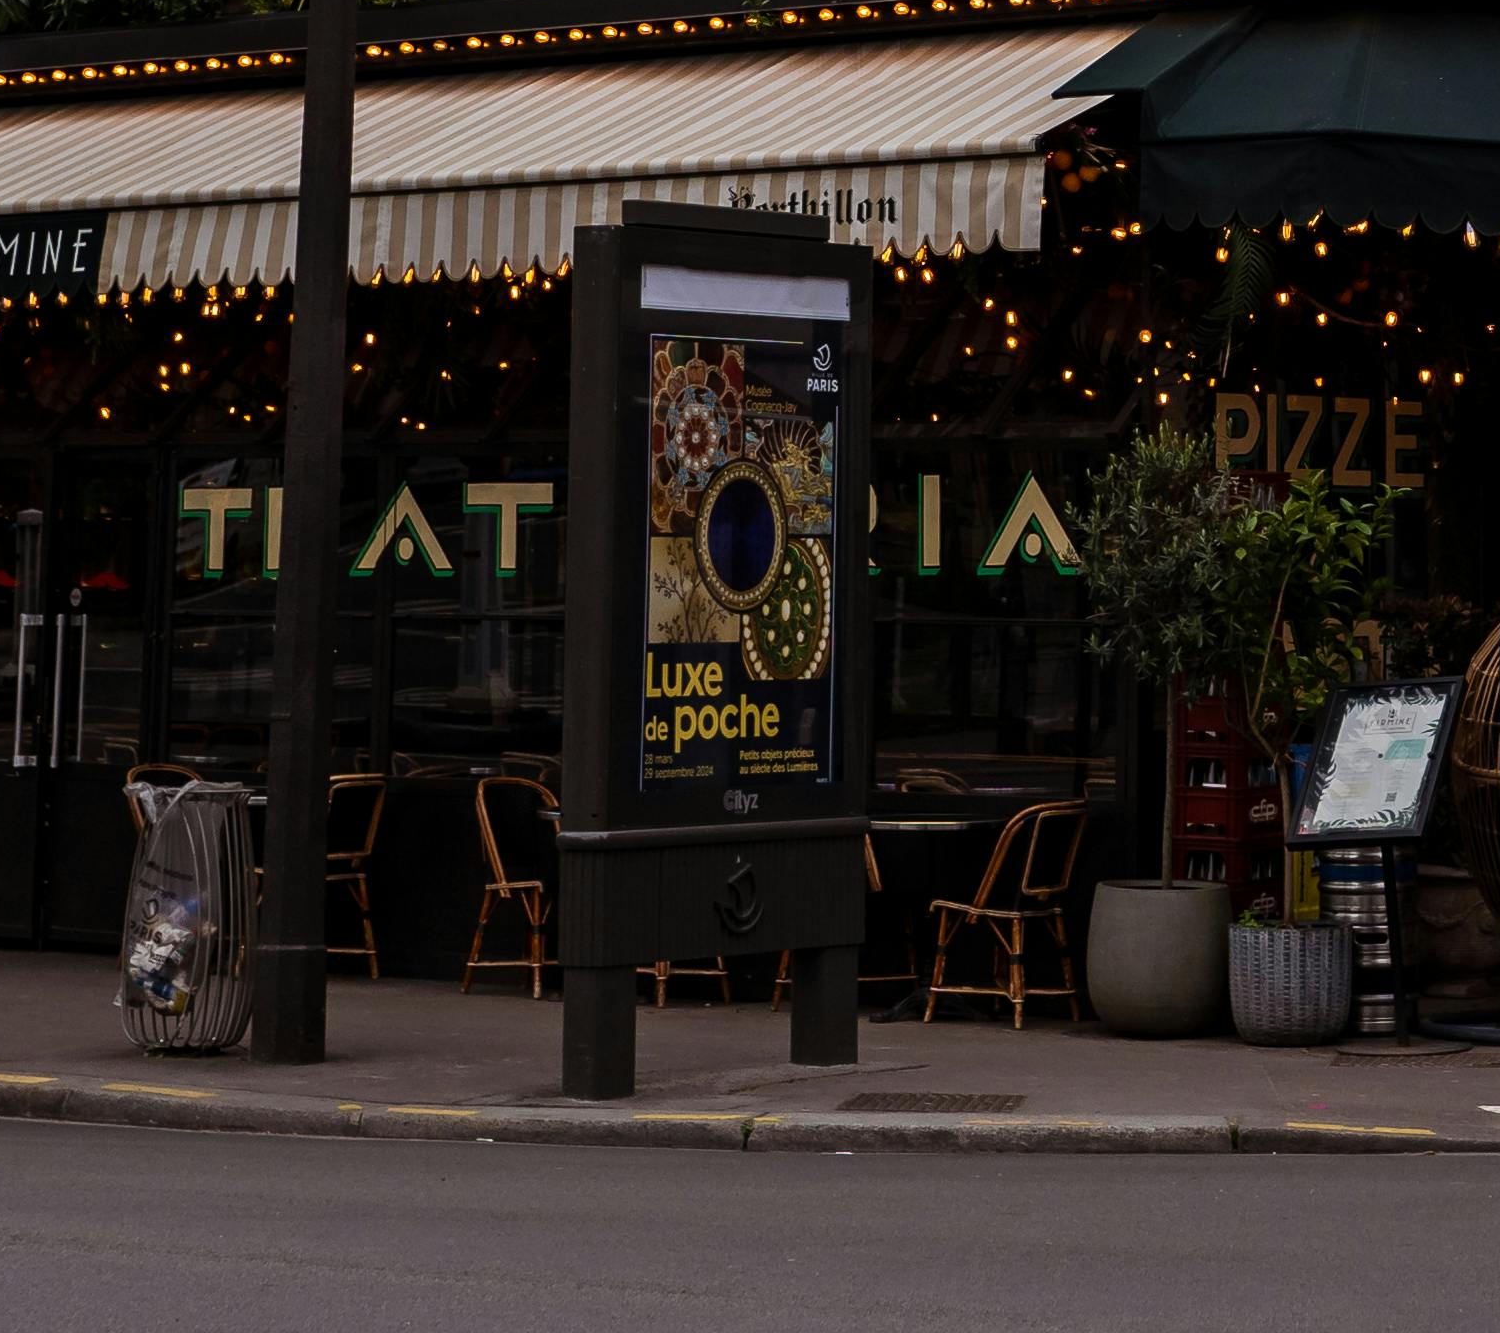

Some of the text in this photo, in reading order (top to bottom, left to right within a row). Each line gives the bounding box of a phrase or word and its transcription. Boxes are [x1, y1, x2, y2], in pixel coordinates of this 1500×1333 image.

[806, 378, 839, 393] PARIS
[1214, 391, 1426, 488] PIZZE
[645, 651, 724, 699] Luxe
[645, 693, 781, 754] de poche
